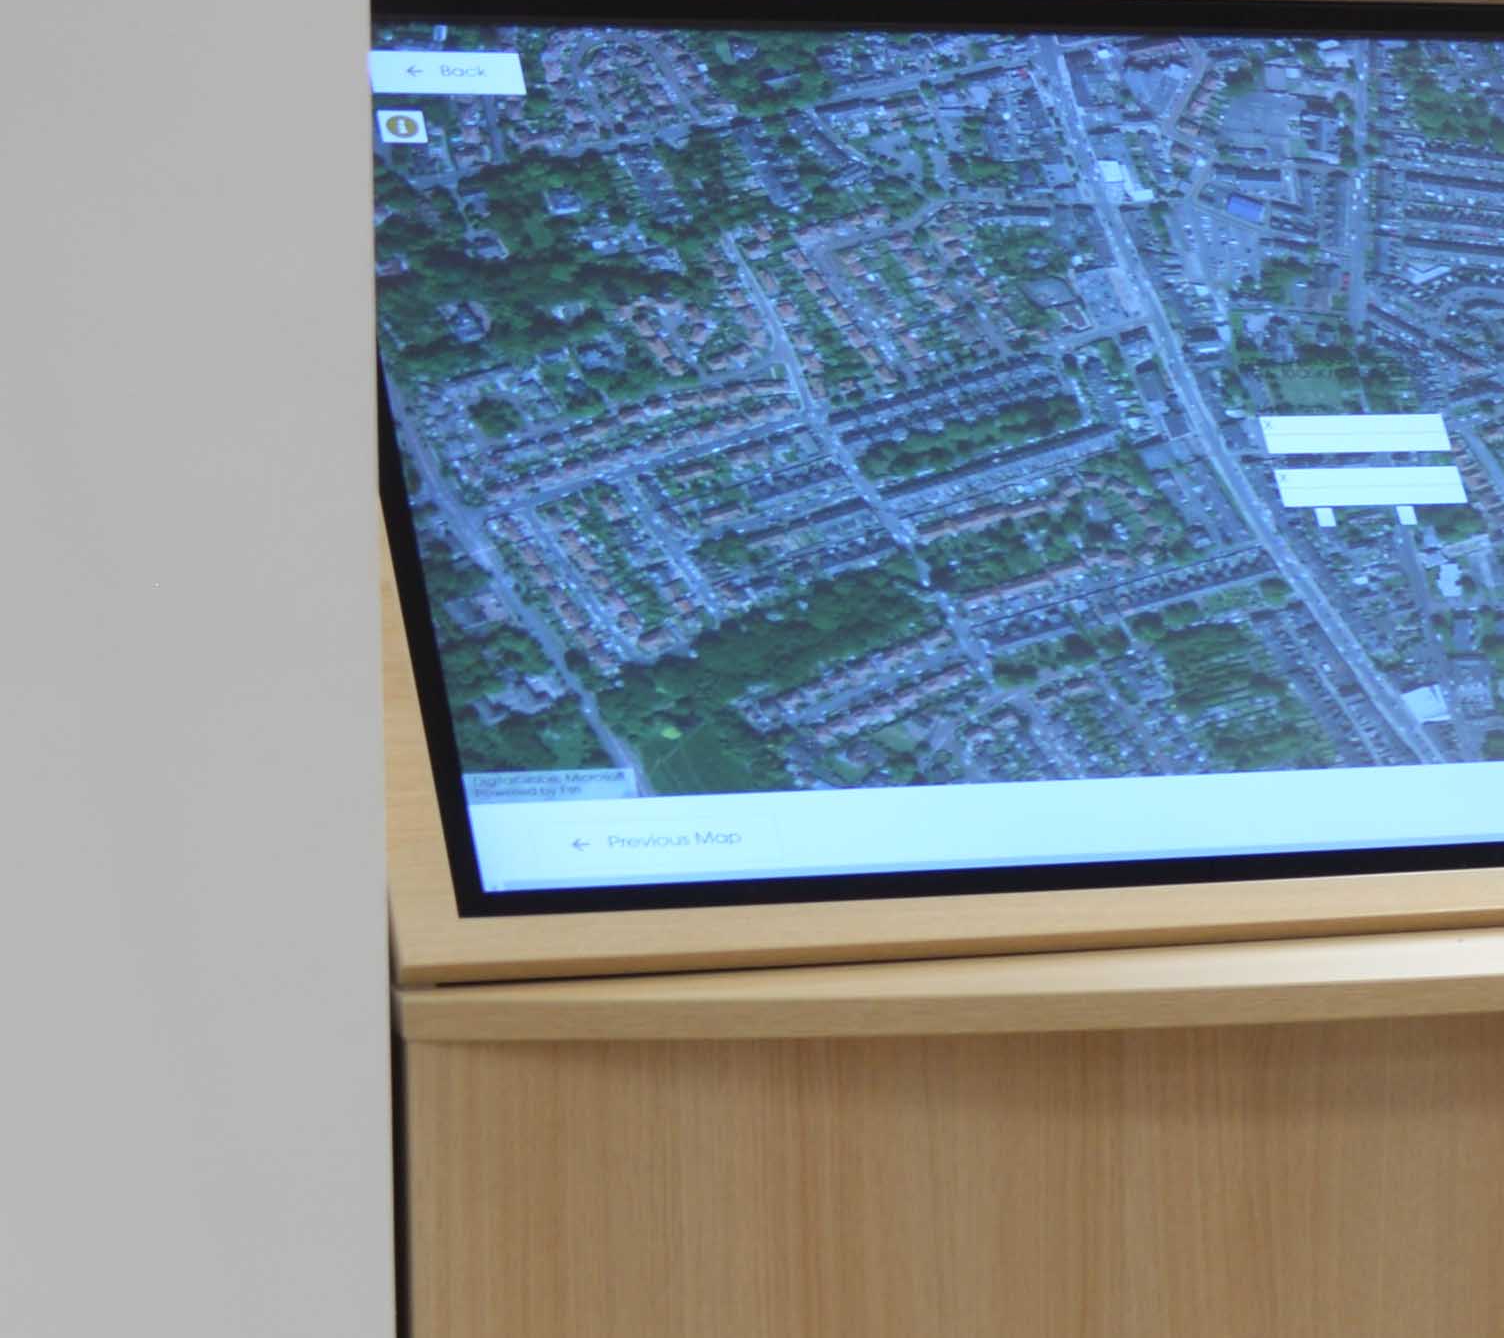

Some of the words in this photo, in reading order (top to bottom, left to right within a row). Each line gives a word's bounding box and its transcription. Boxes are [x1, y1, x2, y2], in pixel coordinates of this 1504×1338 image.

[439, 64, 488, 78] Back
[607, 834, 690, 848] Previous
[695, 831, 743, 847] Map
